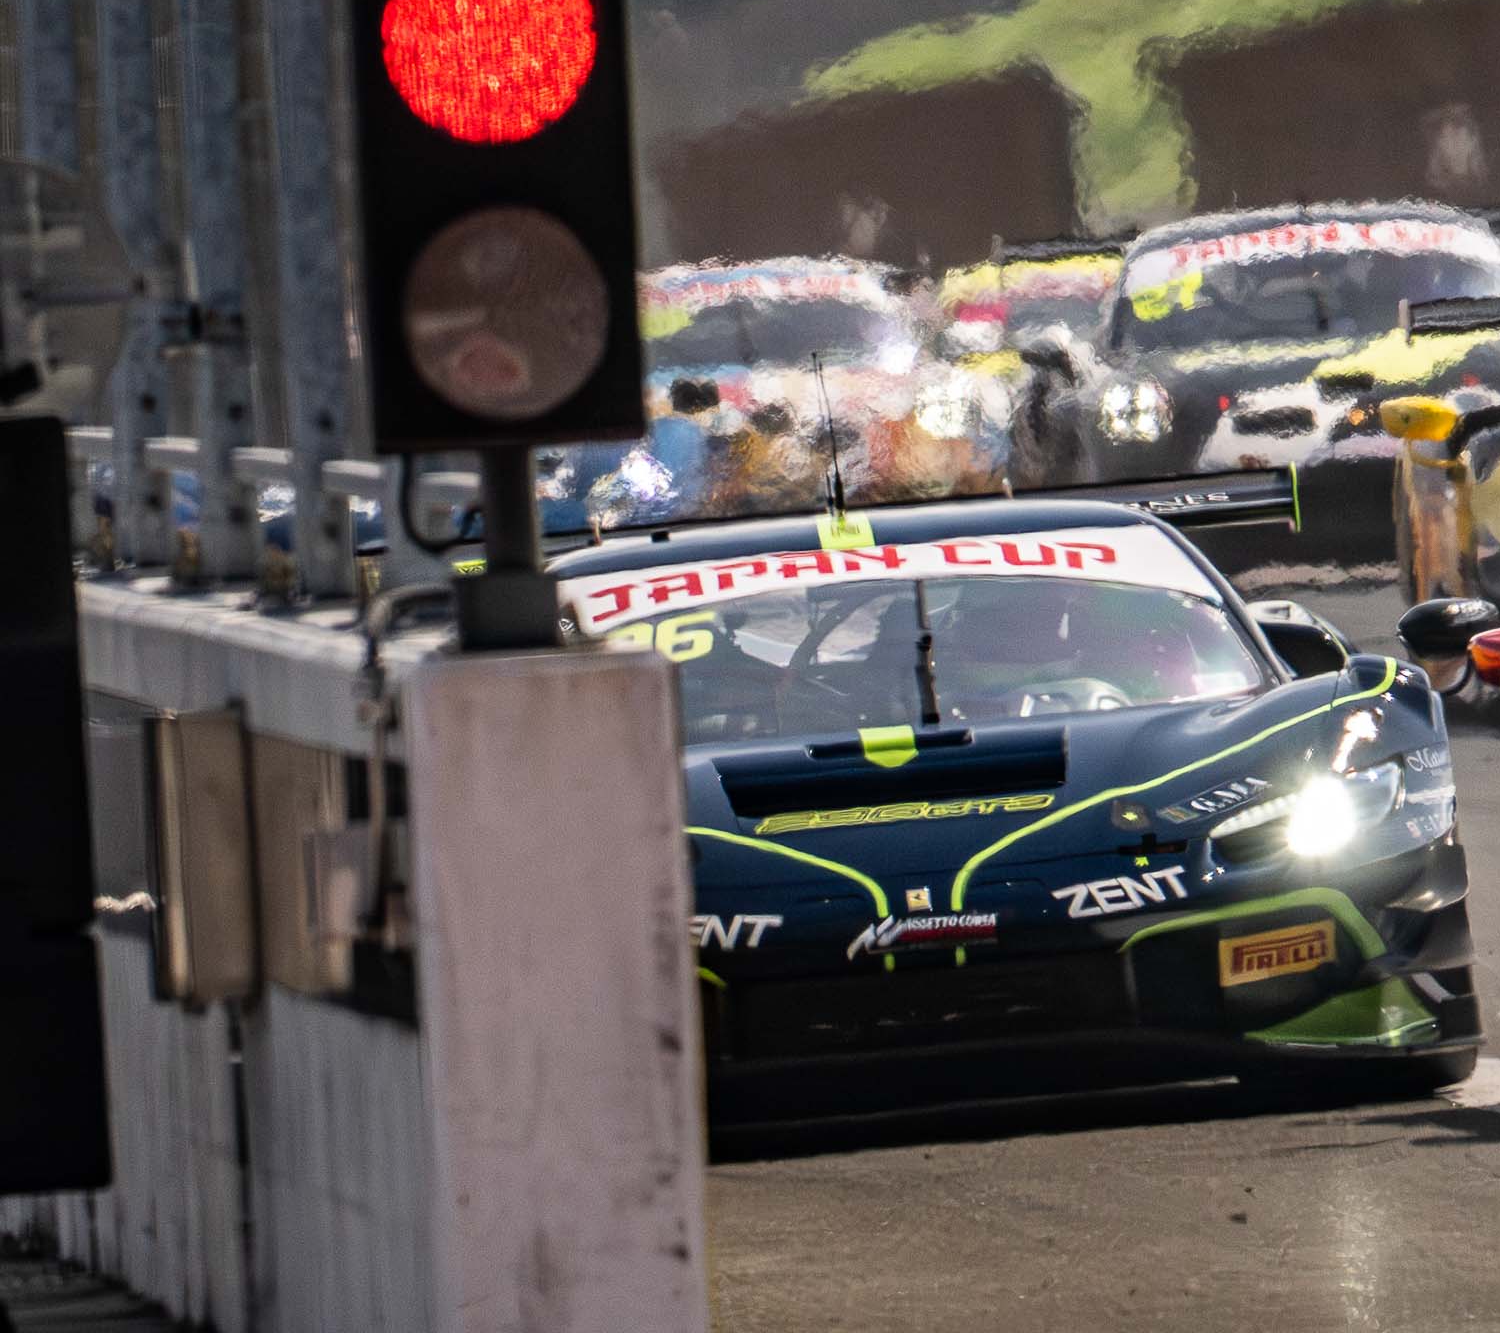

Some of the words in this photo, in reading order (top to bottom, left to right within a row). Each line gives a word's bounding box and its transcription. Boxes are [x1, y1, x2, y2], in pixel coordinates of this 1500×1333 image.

[588, 542, 907, 624] JAPAN
[929, 539, 1117, 571] CUP
[1052, 864, 1188, 920] ZENT
[1231, 930, 1330, 976] PIRELLI
